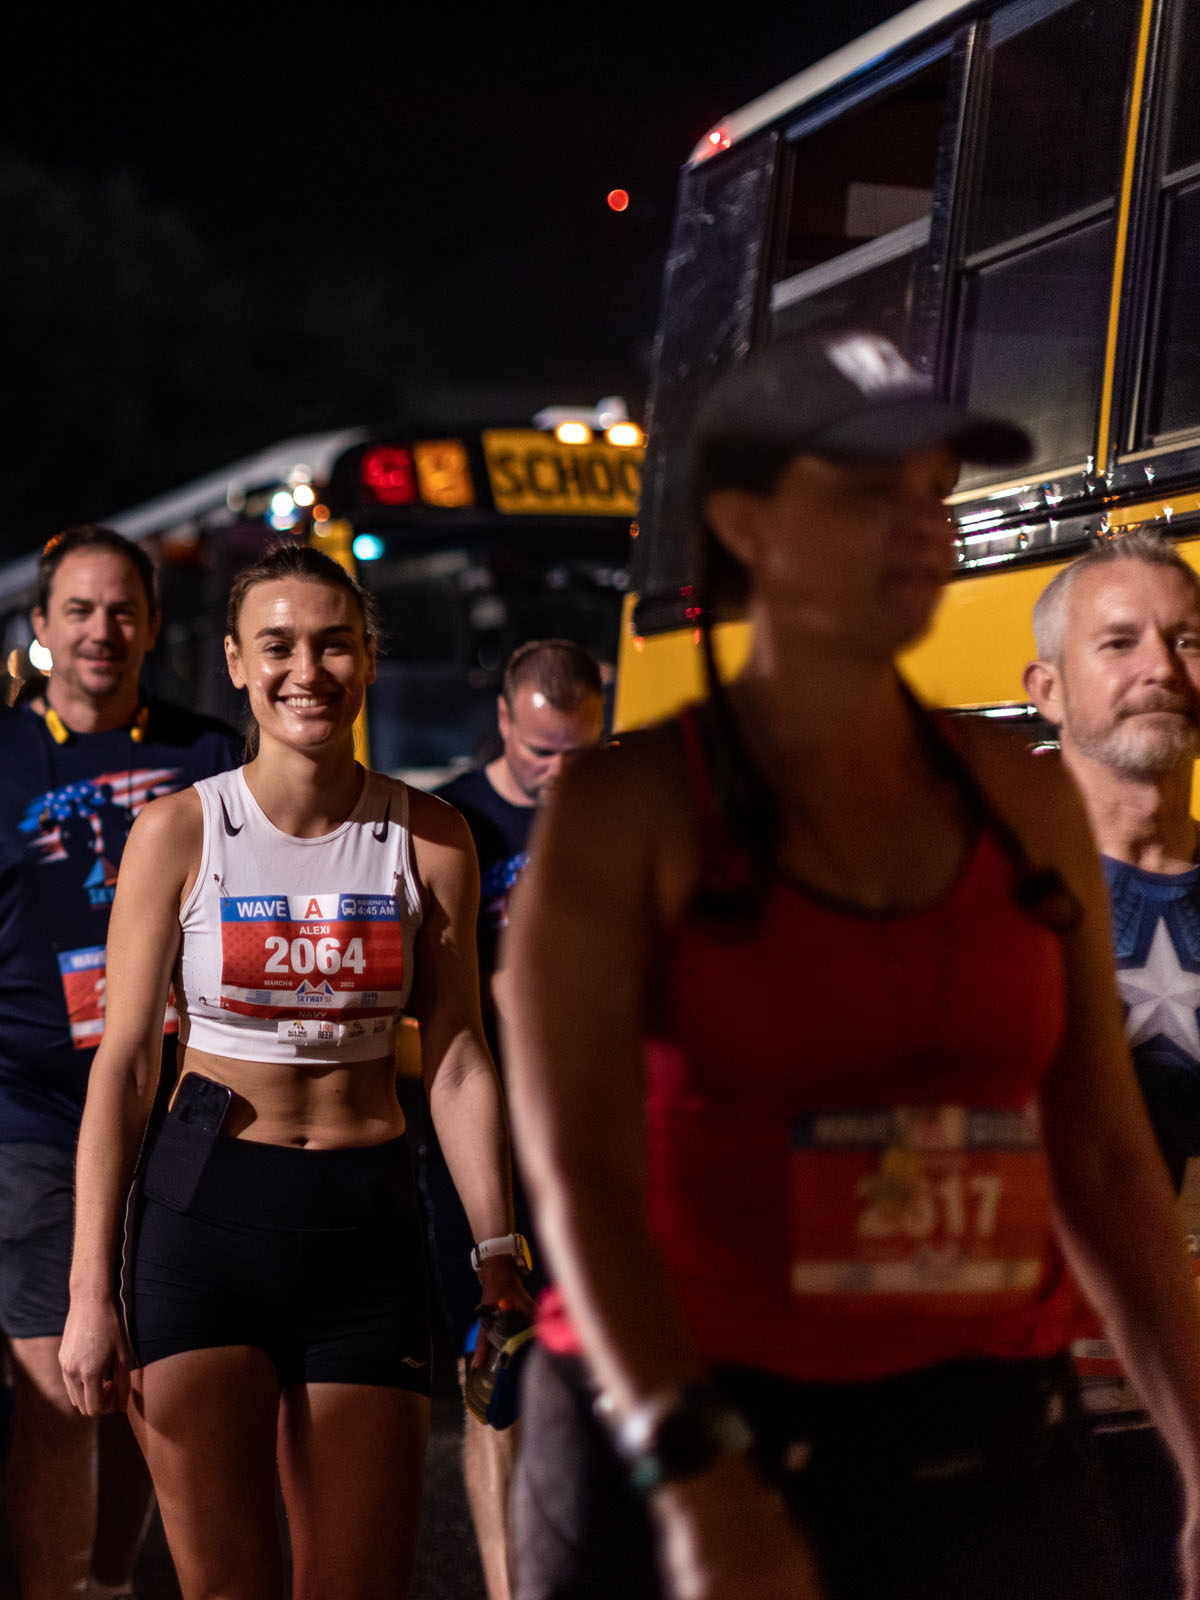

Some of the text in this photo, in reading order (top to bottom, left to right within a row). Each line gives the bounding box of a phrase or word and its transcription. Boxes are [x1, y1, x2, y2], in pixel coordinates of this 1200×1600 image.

[495, 450, 641, 498] SCHOO
[237, 898, 324, 919] WAVE A
[357, 906, 395, 916] 4:45 AM
[299, 926, 330, 935] ALEXI
[72, 952, 106, 969] WAV
[264, 936, 366, 975] 2064
[297, 995, 323, 1003] SKYWAY
[298, 1009, 328, 1019] NAVY
[318, 1031, 334, 1039] BEER
